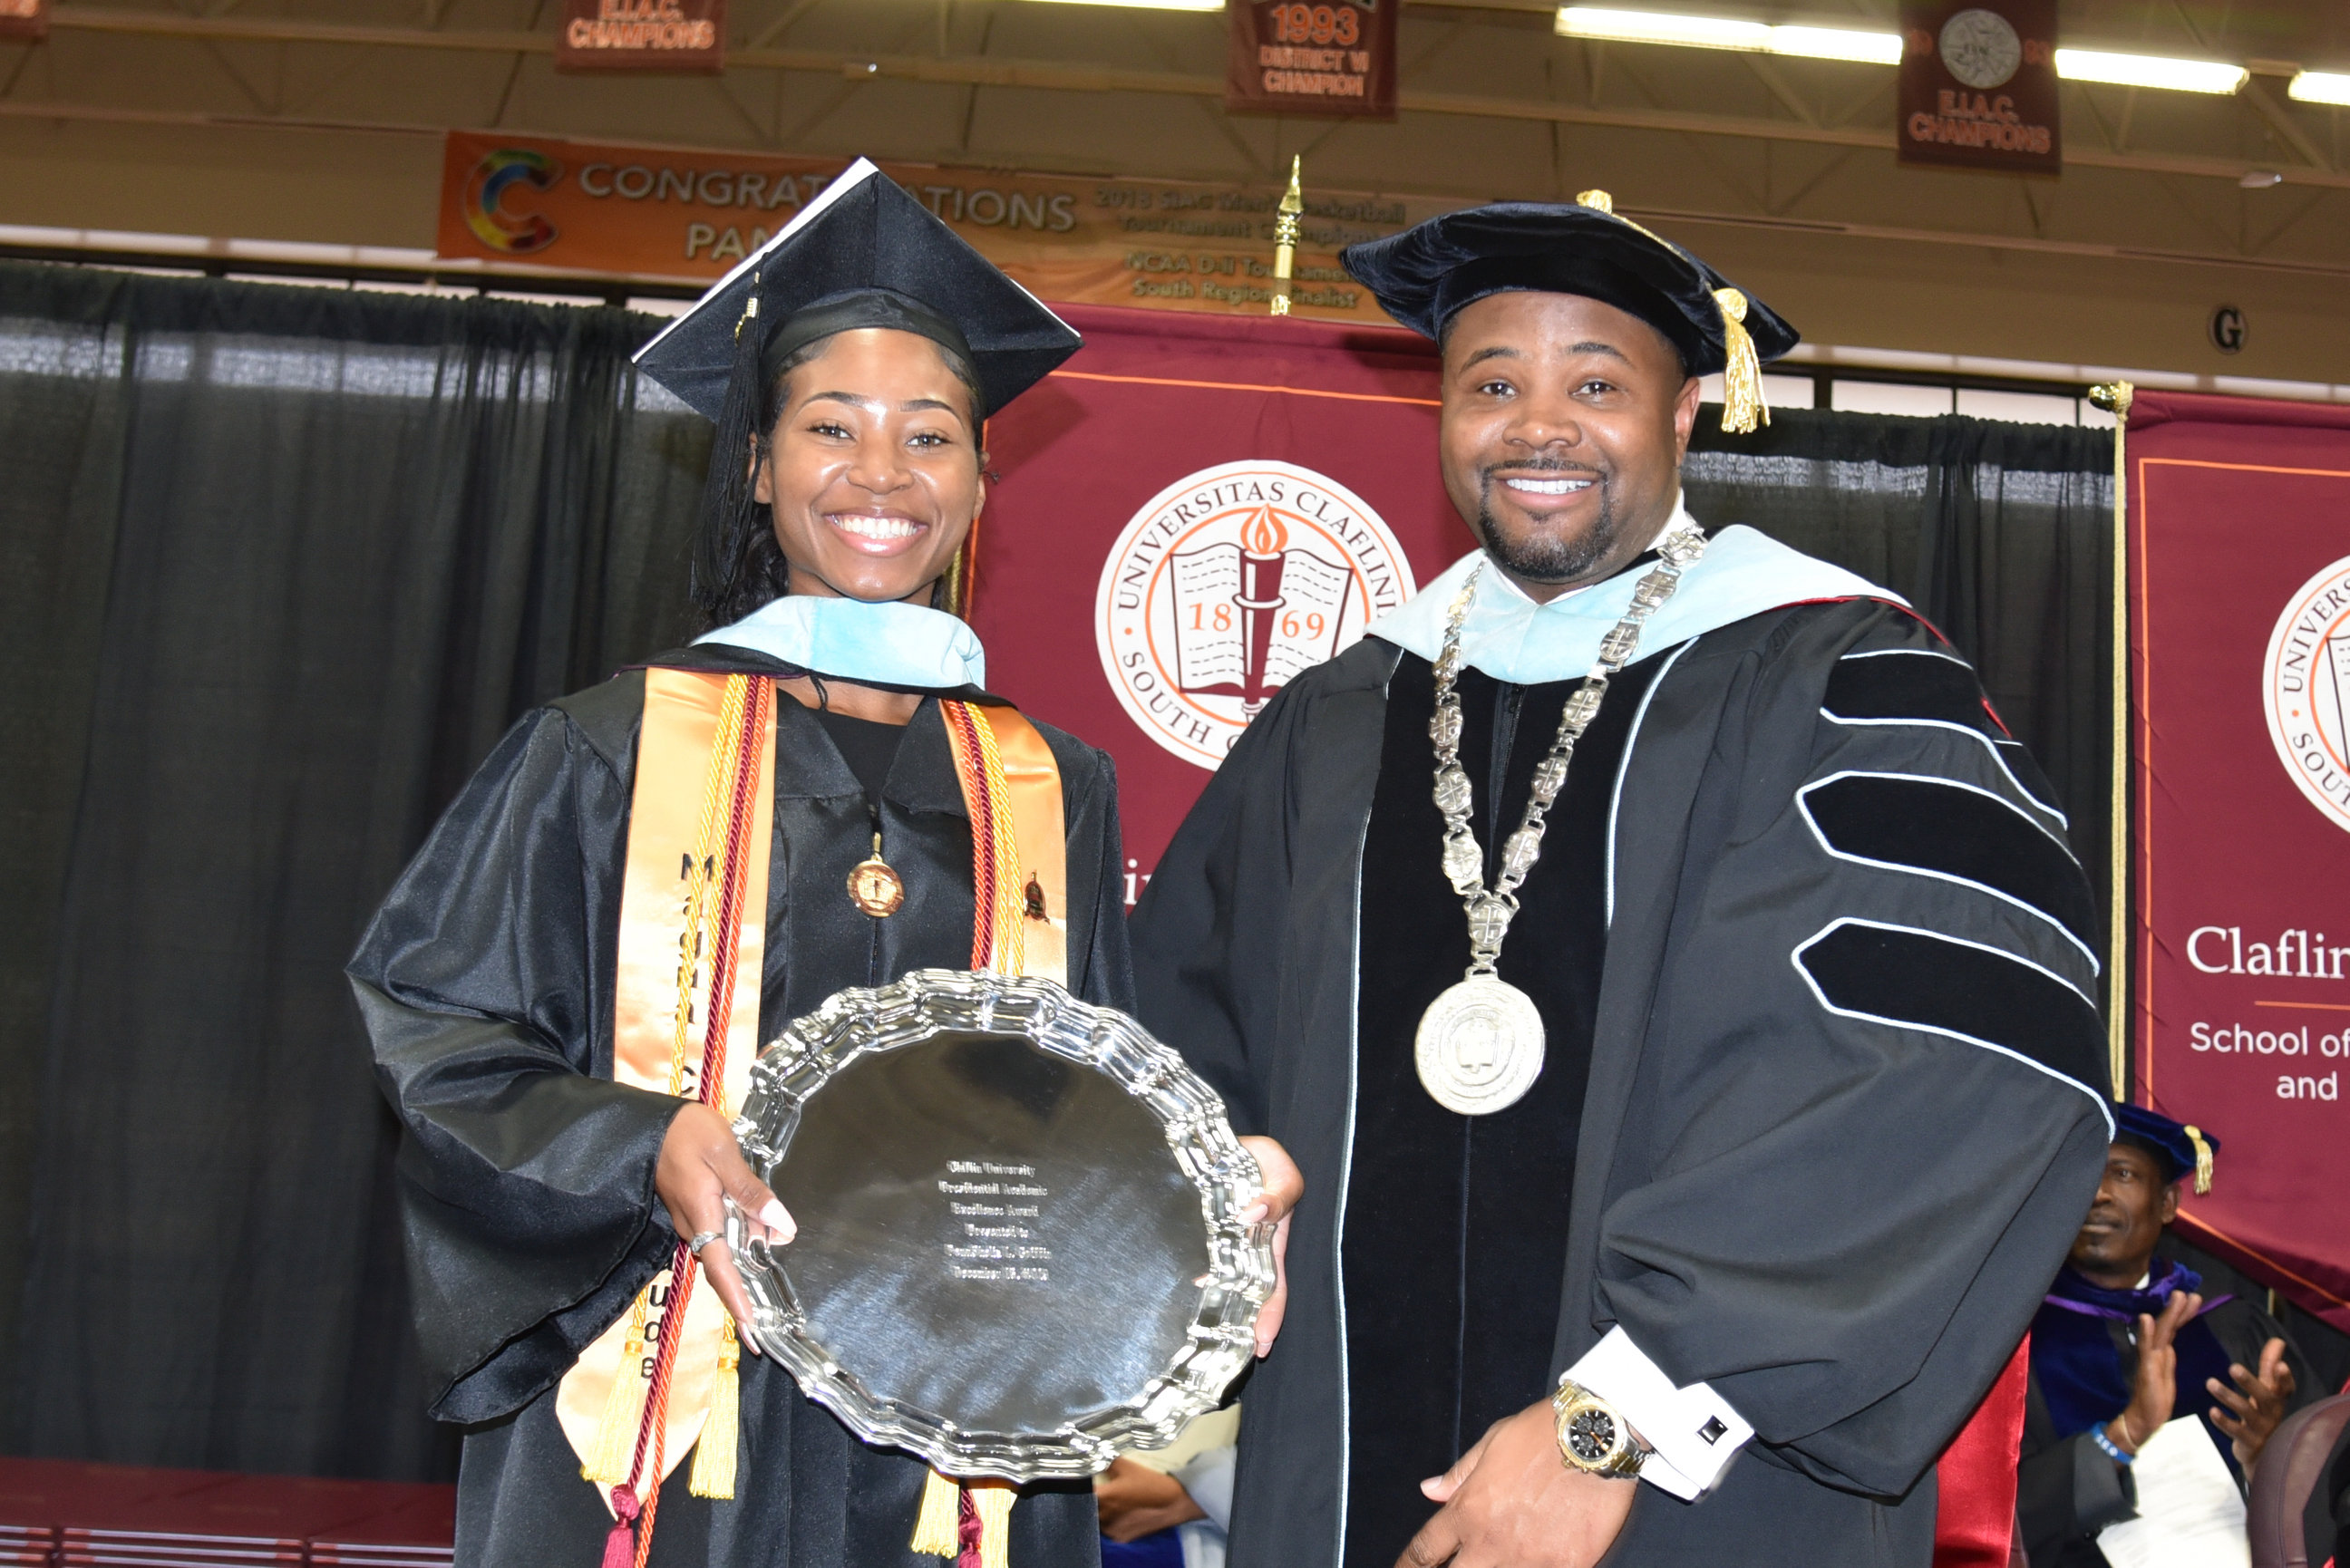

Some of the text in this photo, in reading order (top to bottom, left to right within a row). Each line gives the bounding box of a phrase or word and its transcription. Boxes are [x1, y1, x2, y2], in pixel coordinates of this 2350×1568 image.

[567, 17, 715, 49] CHAMPIONS
[1270, 4, 1359, 45] 1993
[1258, 45, 1345, 71] DISTRICT
[1263, 69, 1364, 97] CHAMPION
[1908, 111, 2052, 154] CHAMPIONS
[1124, 252, 1191, 274] NCAA
[1132, 277, 1194, 299] South
[2213, 307, 2242, 351] G
[1118, 480, 1284, 612] UNIVERSITAS
[1189, 602, 1325, 641] 18 69
[1122, 651, 1213, 745] SOUTH
[2190, 1021, 2308, 1056] School
[2276, 1070, 2338, 1100] and
